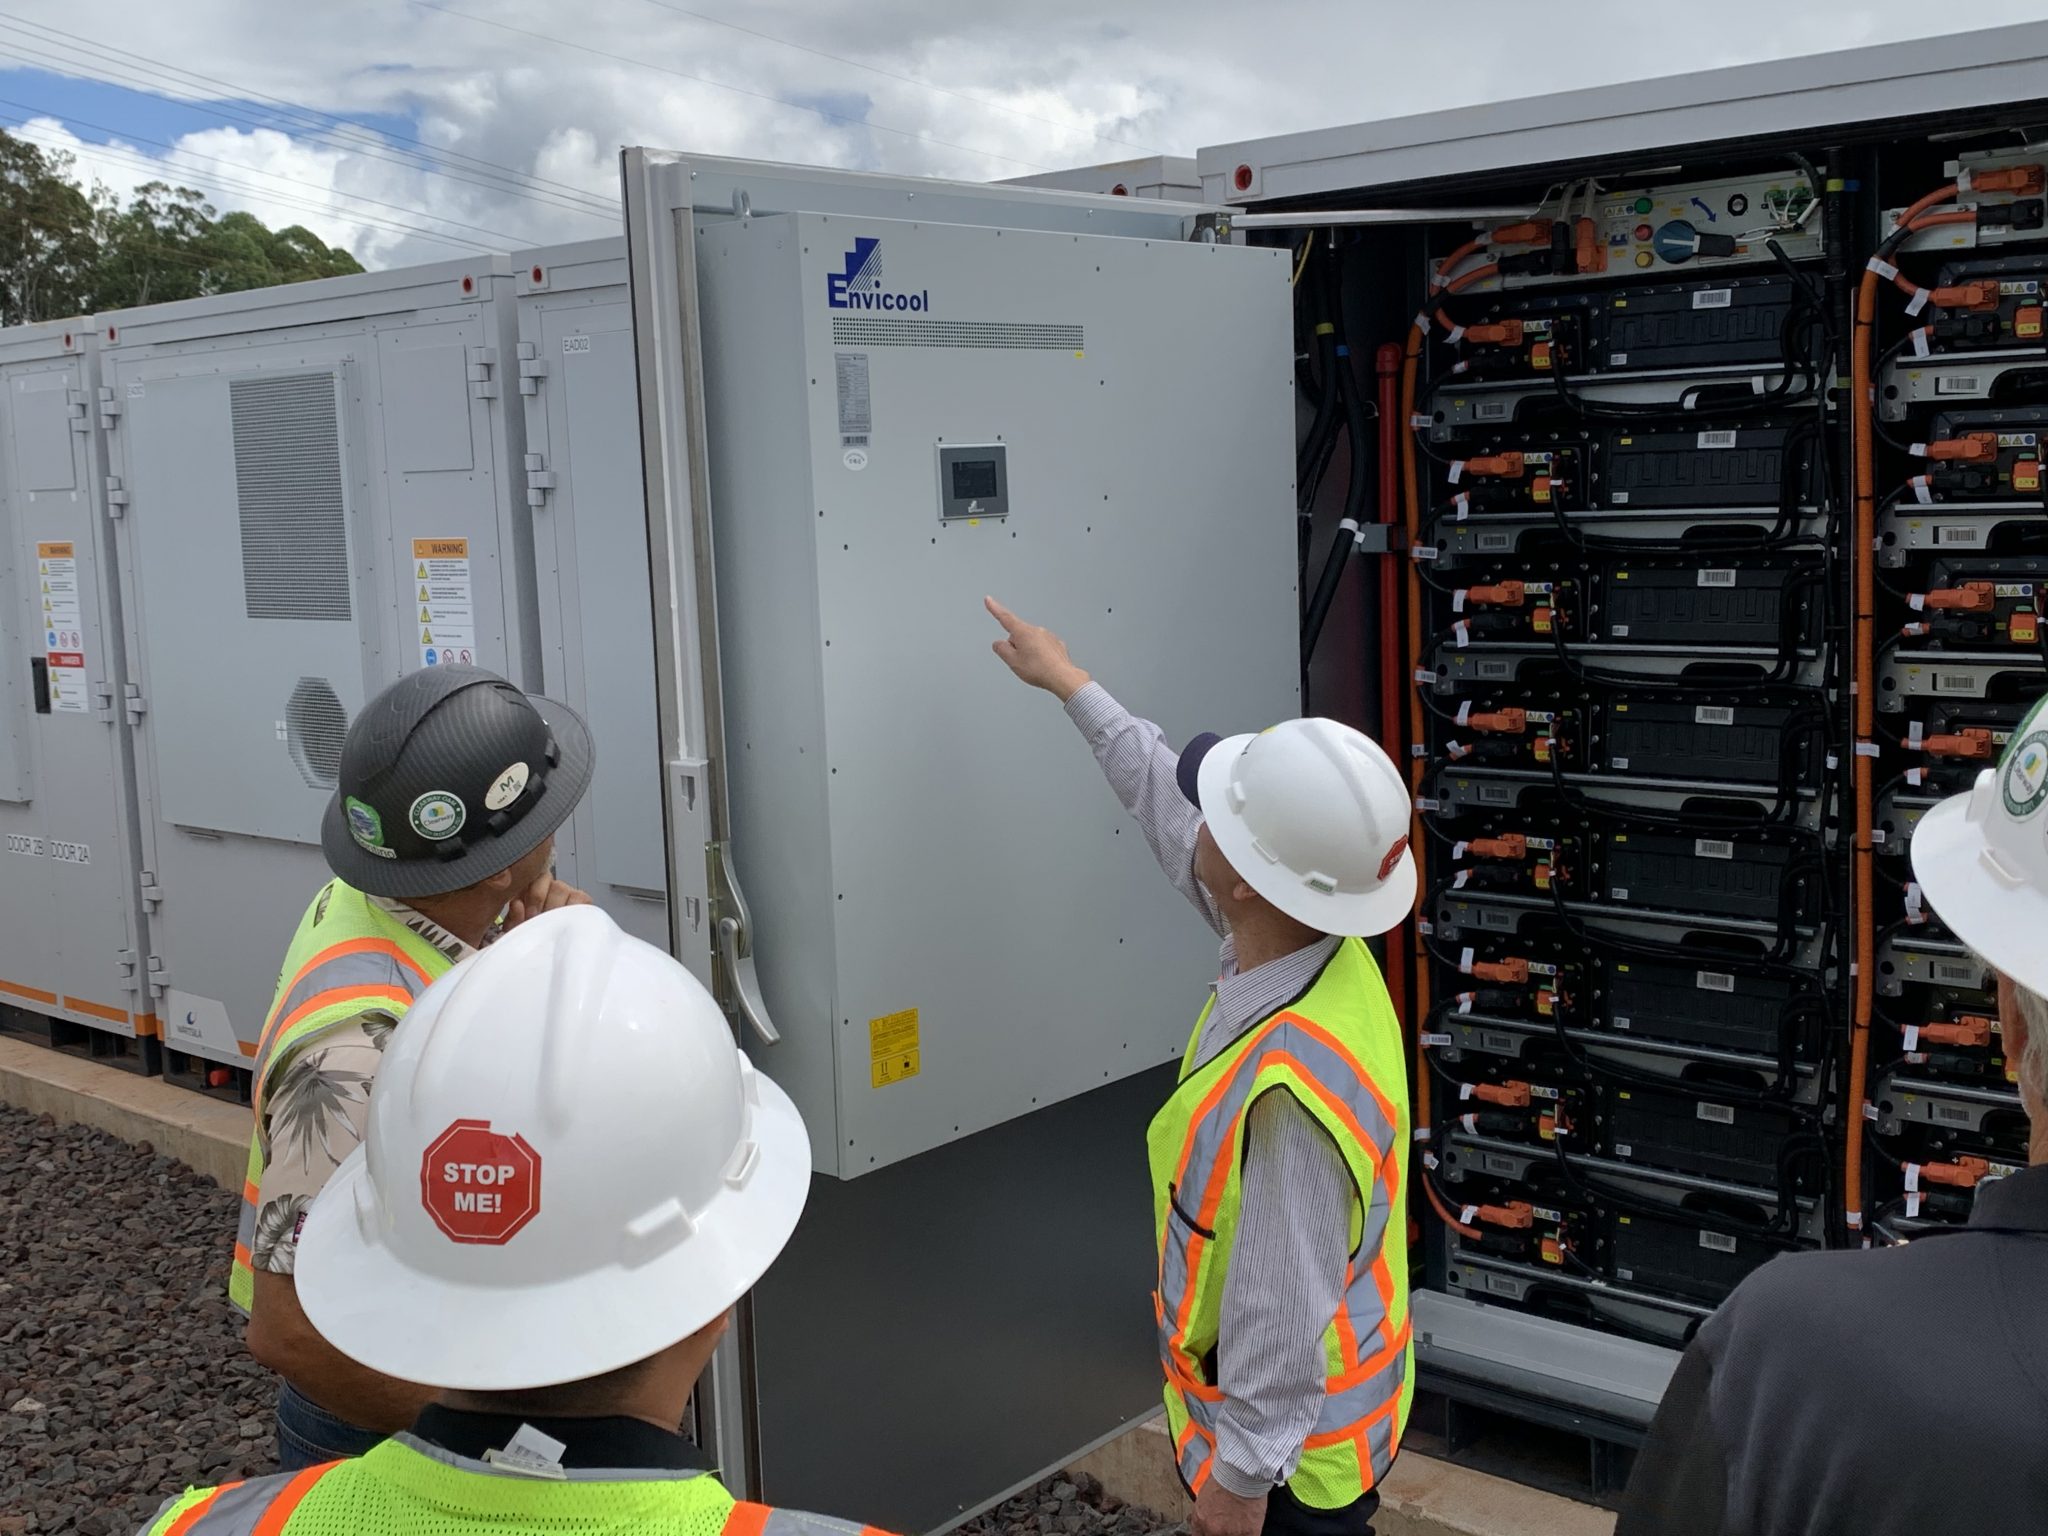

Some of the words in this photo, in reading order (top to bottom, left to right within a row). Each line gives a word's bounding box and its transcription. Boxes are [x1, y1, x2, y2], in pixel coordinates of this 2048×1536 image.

[827, 273, 929, 312] Envicool
[563, 338, 589, 351] EAD02
[431, 543, 464, 555] WARNING
[413, 795, 441, 816] CLEARWAY
[423, 813, 455, 827] Clearway
[443, 1162, 516, 1186] STOP
[454, 1191, 502, 1214] ME!
